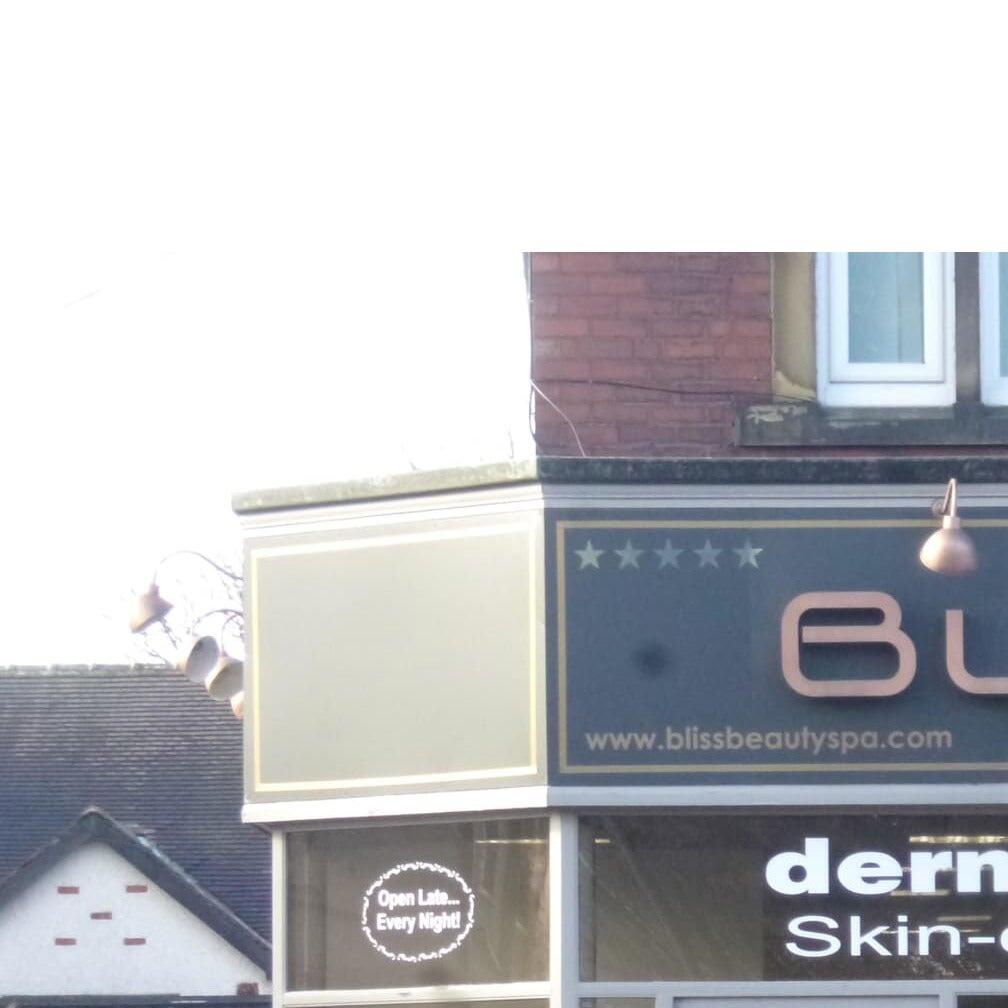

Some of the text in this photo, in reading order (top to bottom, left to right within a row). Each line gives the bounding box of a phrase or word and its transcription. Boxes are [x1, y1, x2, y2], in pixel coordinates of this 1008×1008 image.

[585, 726, 953, 755] www.blissbeautyspa.com
[377, 889, 416, 910] Open
[376, 911, 461, 934] Every Night!
